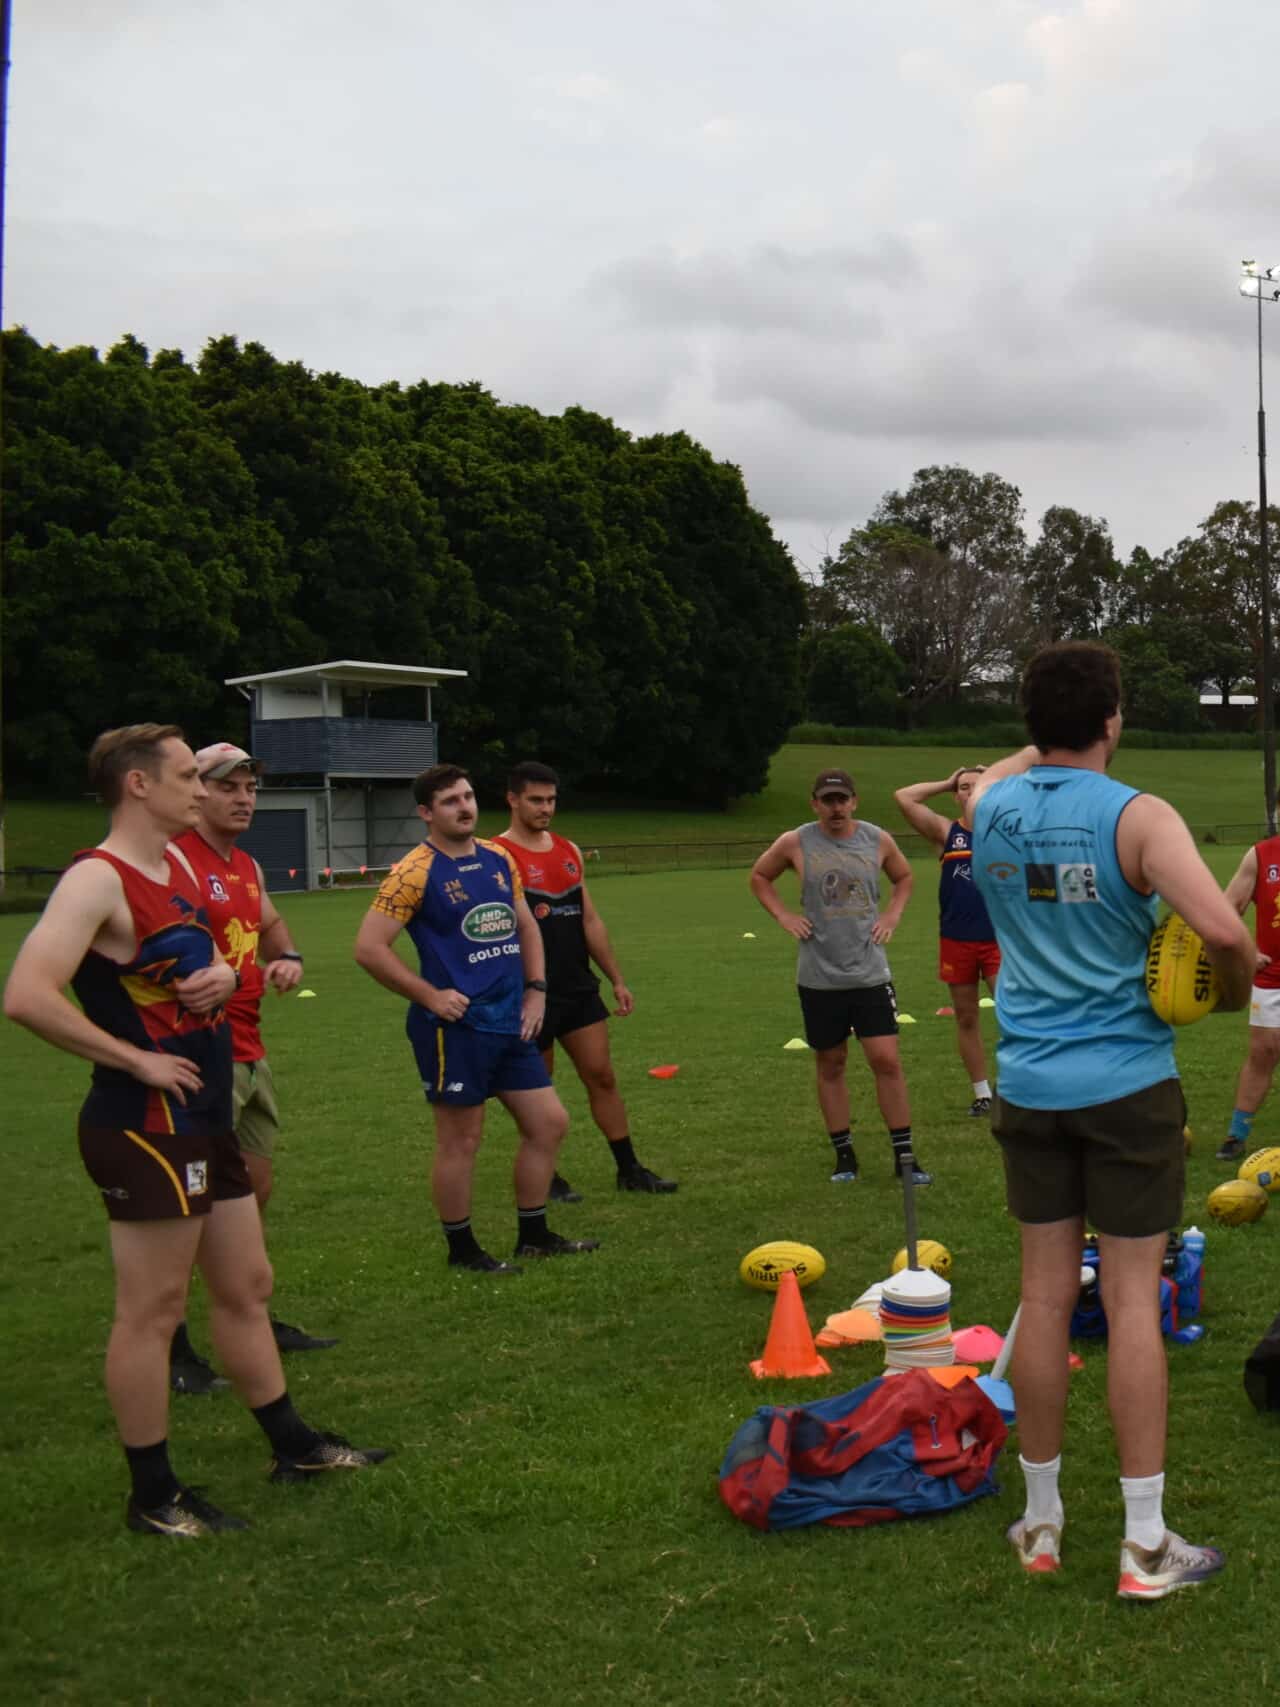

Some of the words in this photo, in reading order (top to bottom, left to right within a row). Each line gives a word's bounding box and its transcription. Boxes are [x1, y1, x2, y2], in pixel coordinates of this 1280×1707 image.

[474, 910, 503, 924] LAND
[480, 919, 513, 934] ROVER
[468, 946, 502, 964] GOLD
